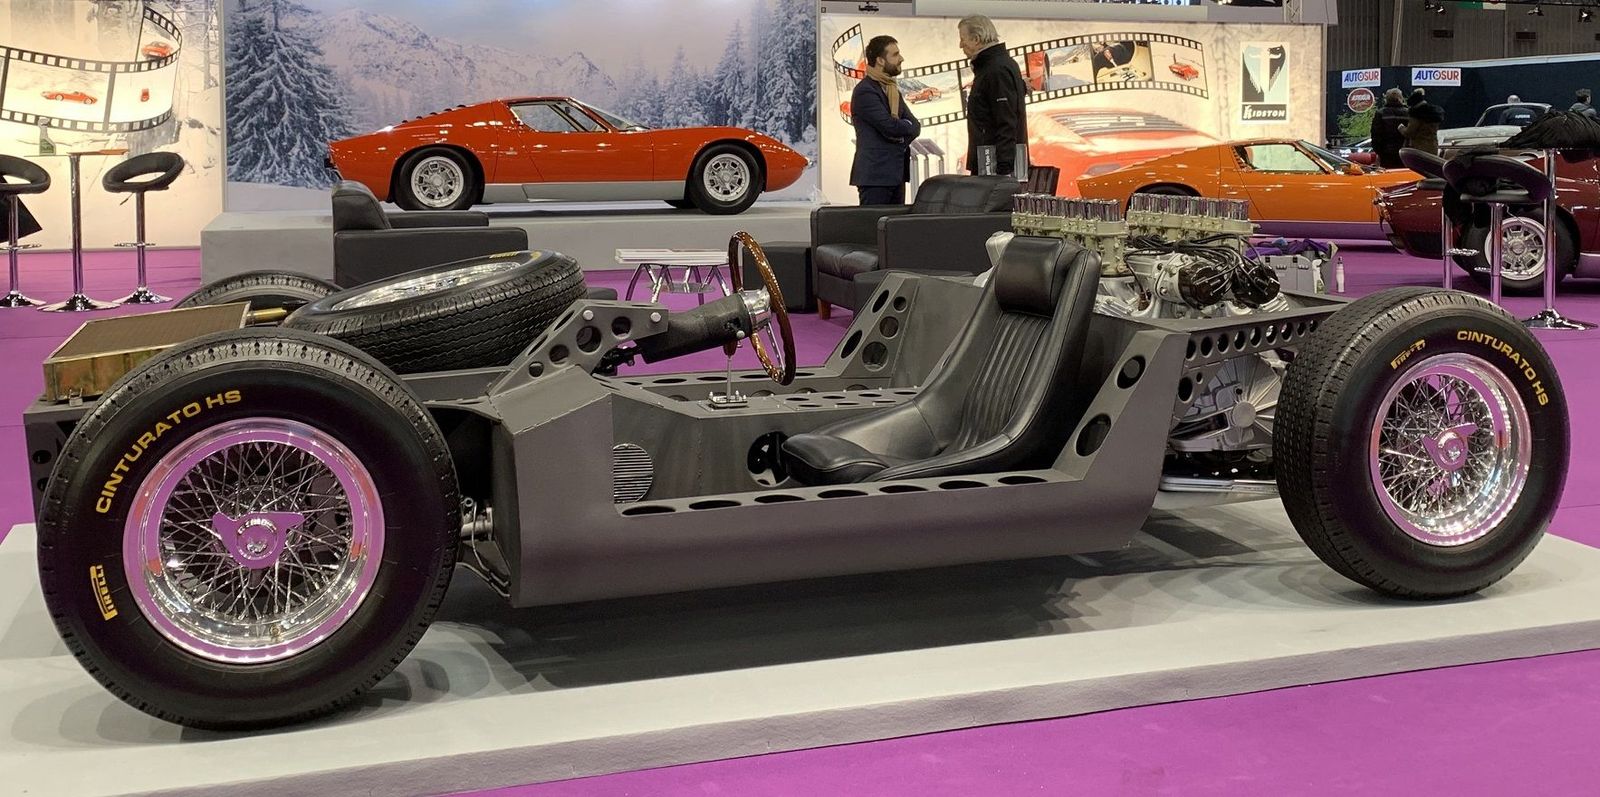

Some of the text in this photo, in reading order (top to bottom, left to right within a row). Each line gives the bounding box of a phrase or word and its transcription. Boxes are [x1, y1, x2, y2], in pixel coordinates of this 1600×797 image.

[1344, 71, 1379, 82] AUTOSUR
[1414, 70, 1459, 81] AUTOSUR
[1243, 105, 1286, 119] KIDSTON
[1457, 330, 1549, 406] CINTURATO HS
[95, 390, 242, 514] CINTURATO HS
[90, 565, 118, 620] PIRELLI
